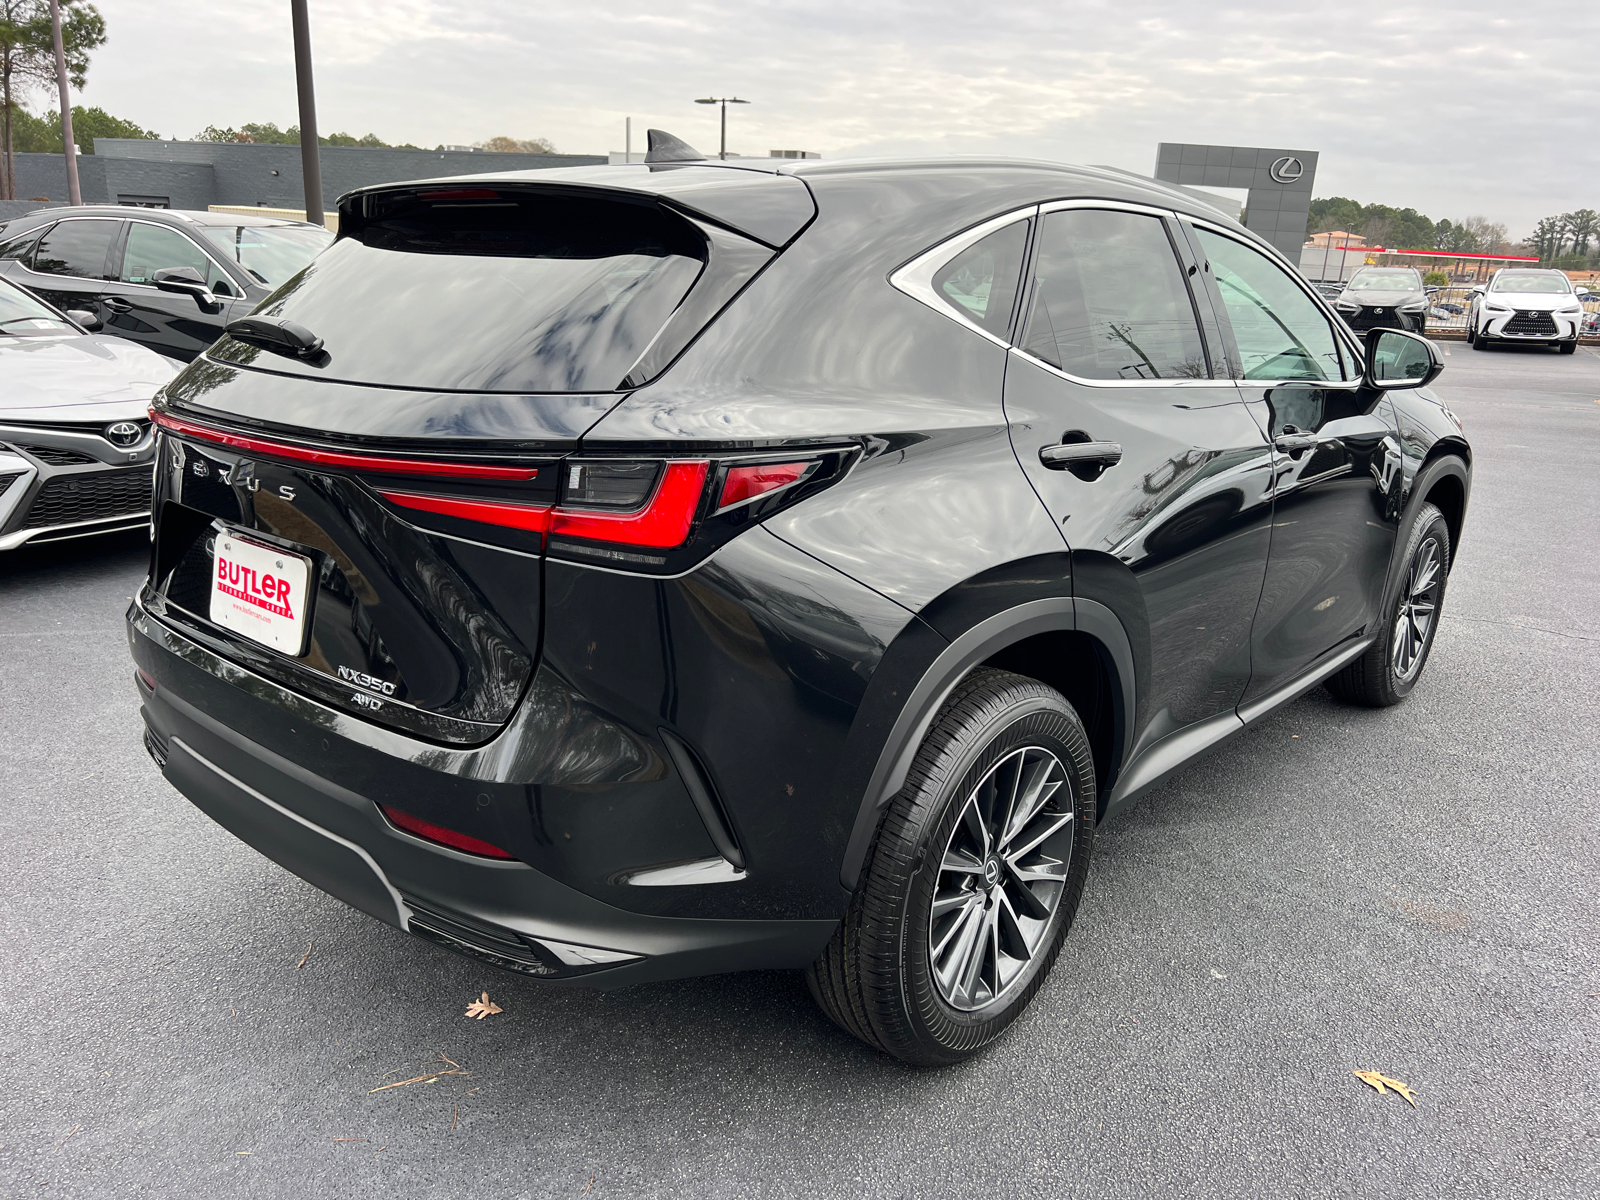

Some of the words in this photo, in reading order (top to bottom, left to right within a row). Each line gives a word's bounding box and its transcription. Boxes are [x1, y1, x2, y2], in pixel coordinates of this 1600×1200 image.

[173, 455, 297, 501] LEXUS
[266, 602, 292, 618] GROUP
[337, 665, 397, 695] NX350
[351, 693, 384, 711] AWD
